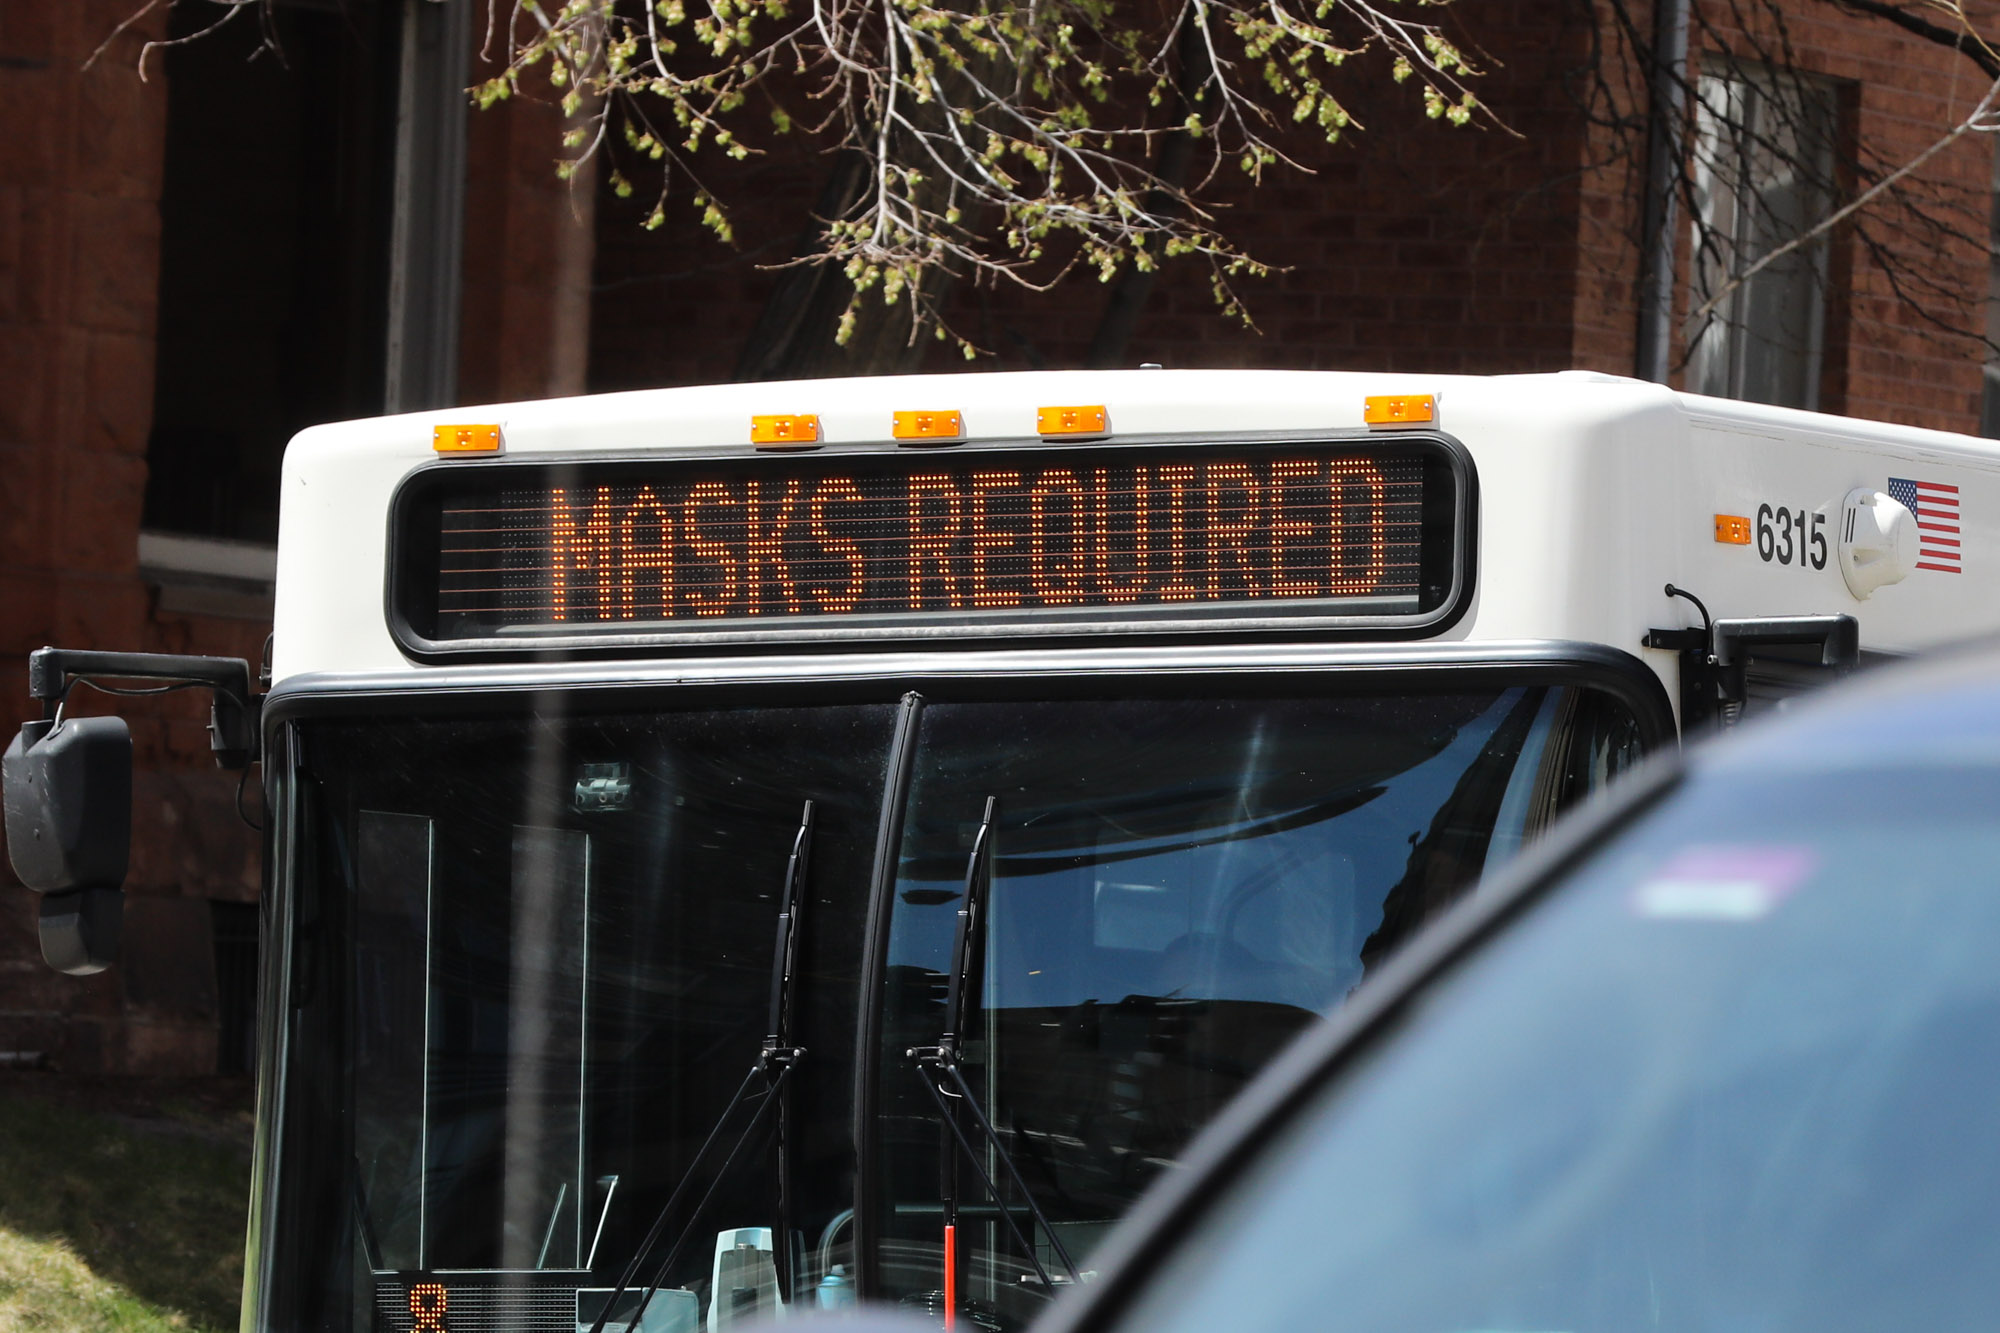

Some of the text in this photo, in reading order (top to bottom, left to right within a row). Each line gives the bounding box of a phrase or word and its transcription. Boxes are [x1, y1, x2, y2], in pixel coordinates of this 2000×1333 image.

[552, 458, 1385, 620] MASKS REQUIRED
[1757, 503, 1828, 570] 6315
